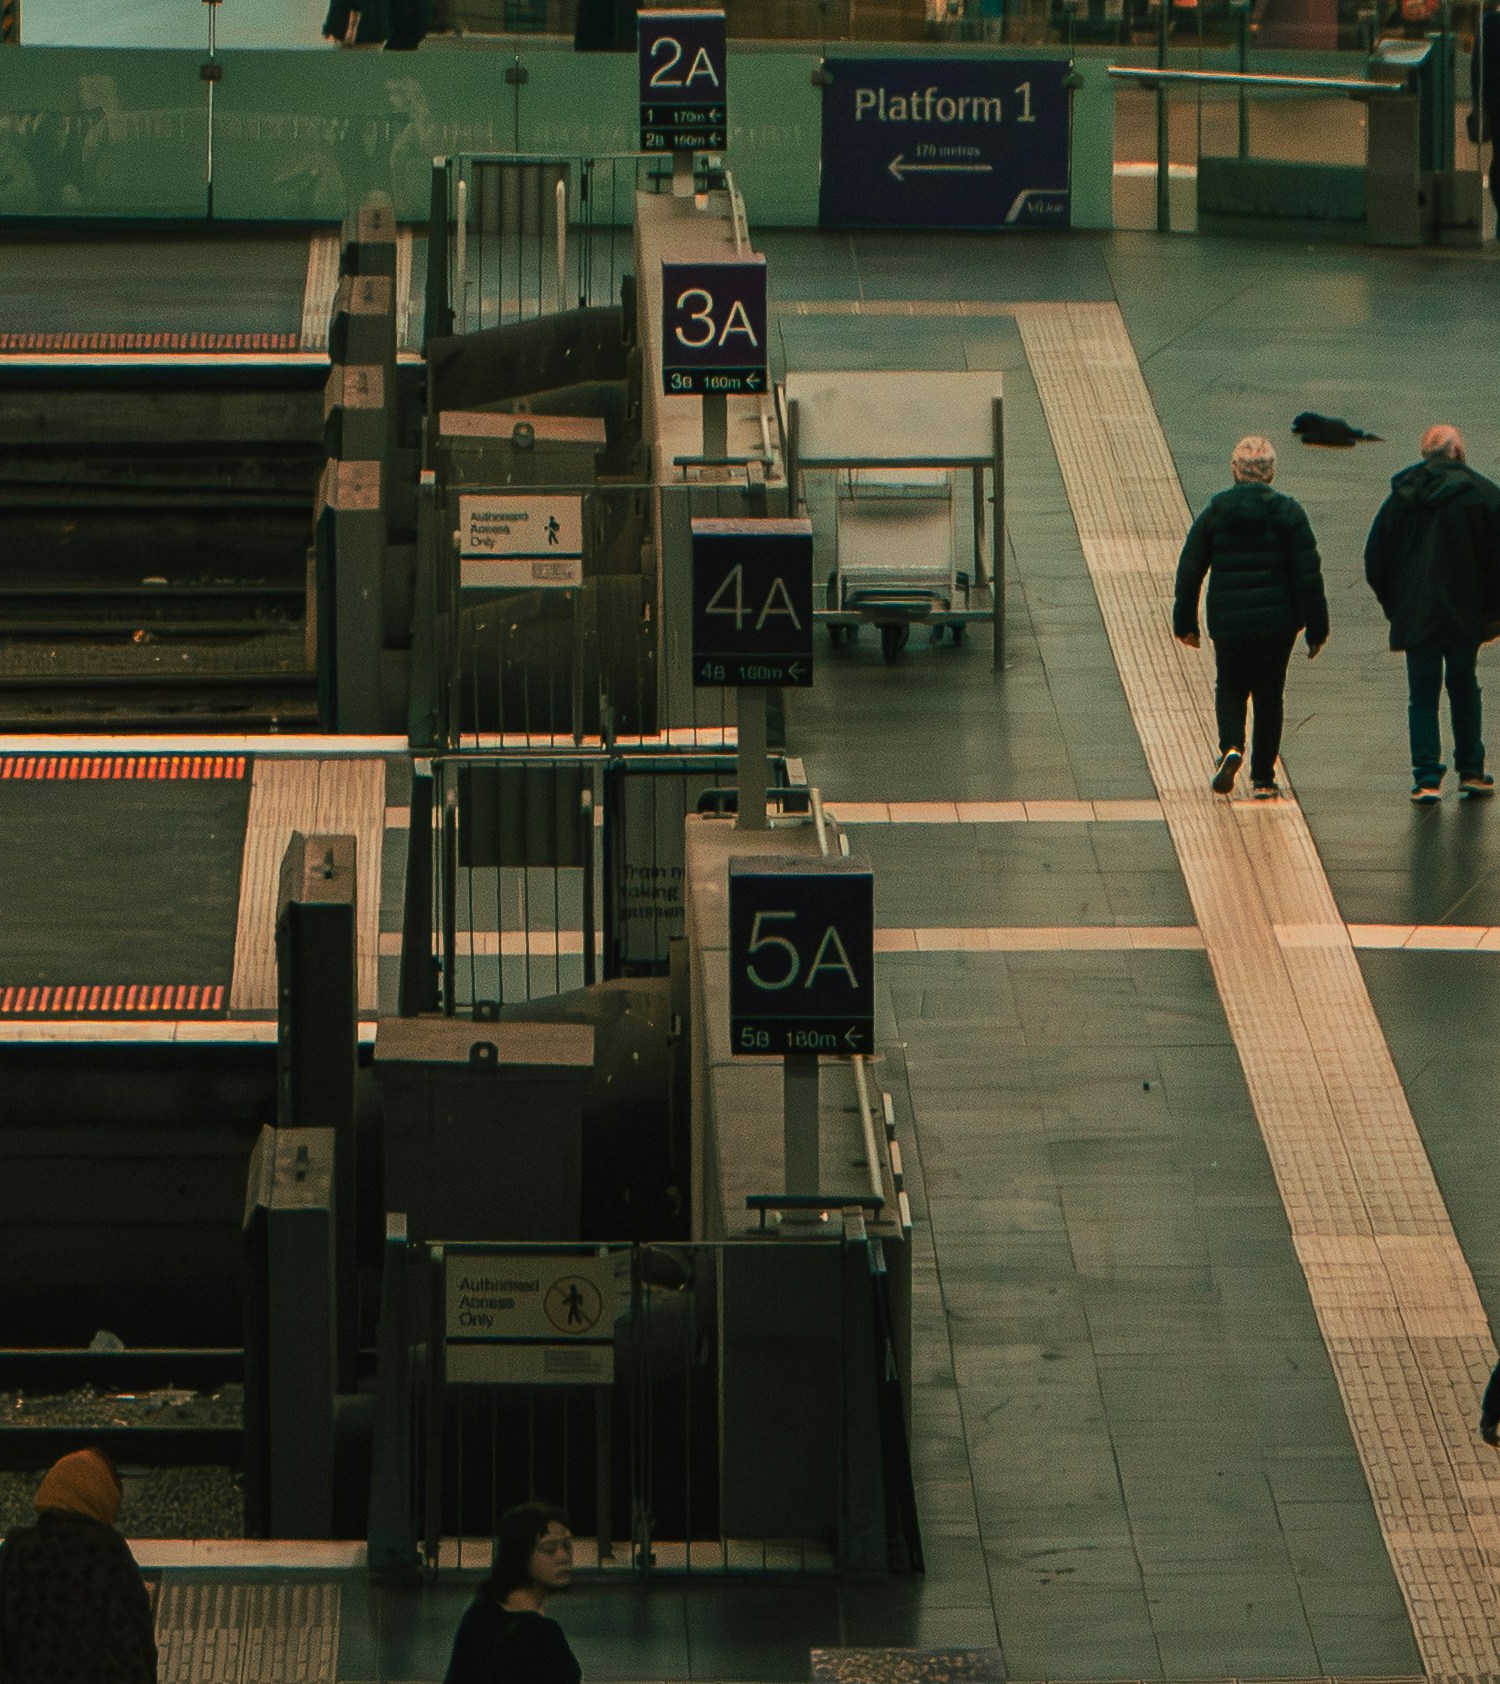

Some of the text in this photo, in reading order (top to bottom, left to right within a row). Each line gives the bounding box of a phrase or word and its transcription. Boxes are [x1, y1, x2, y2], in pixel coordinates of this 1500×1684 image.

[649, 36, 719, 88] 2A
[854, 80, 1037, 123] Platform 1
[674, 288, 759, 349] 3A
[704, 562, 802, 631] 4A
[746, 910, 860, 991] 5A
[741, 1026, 771, 1048] 5B
